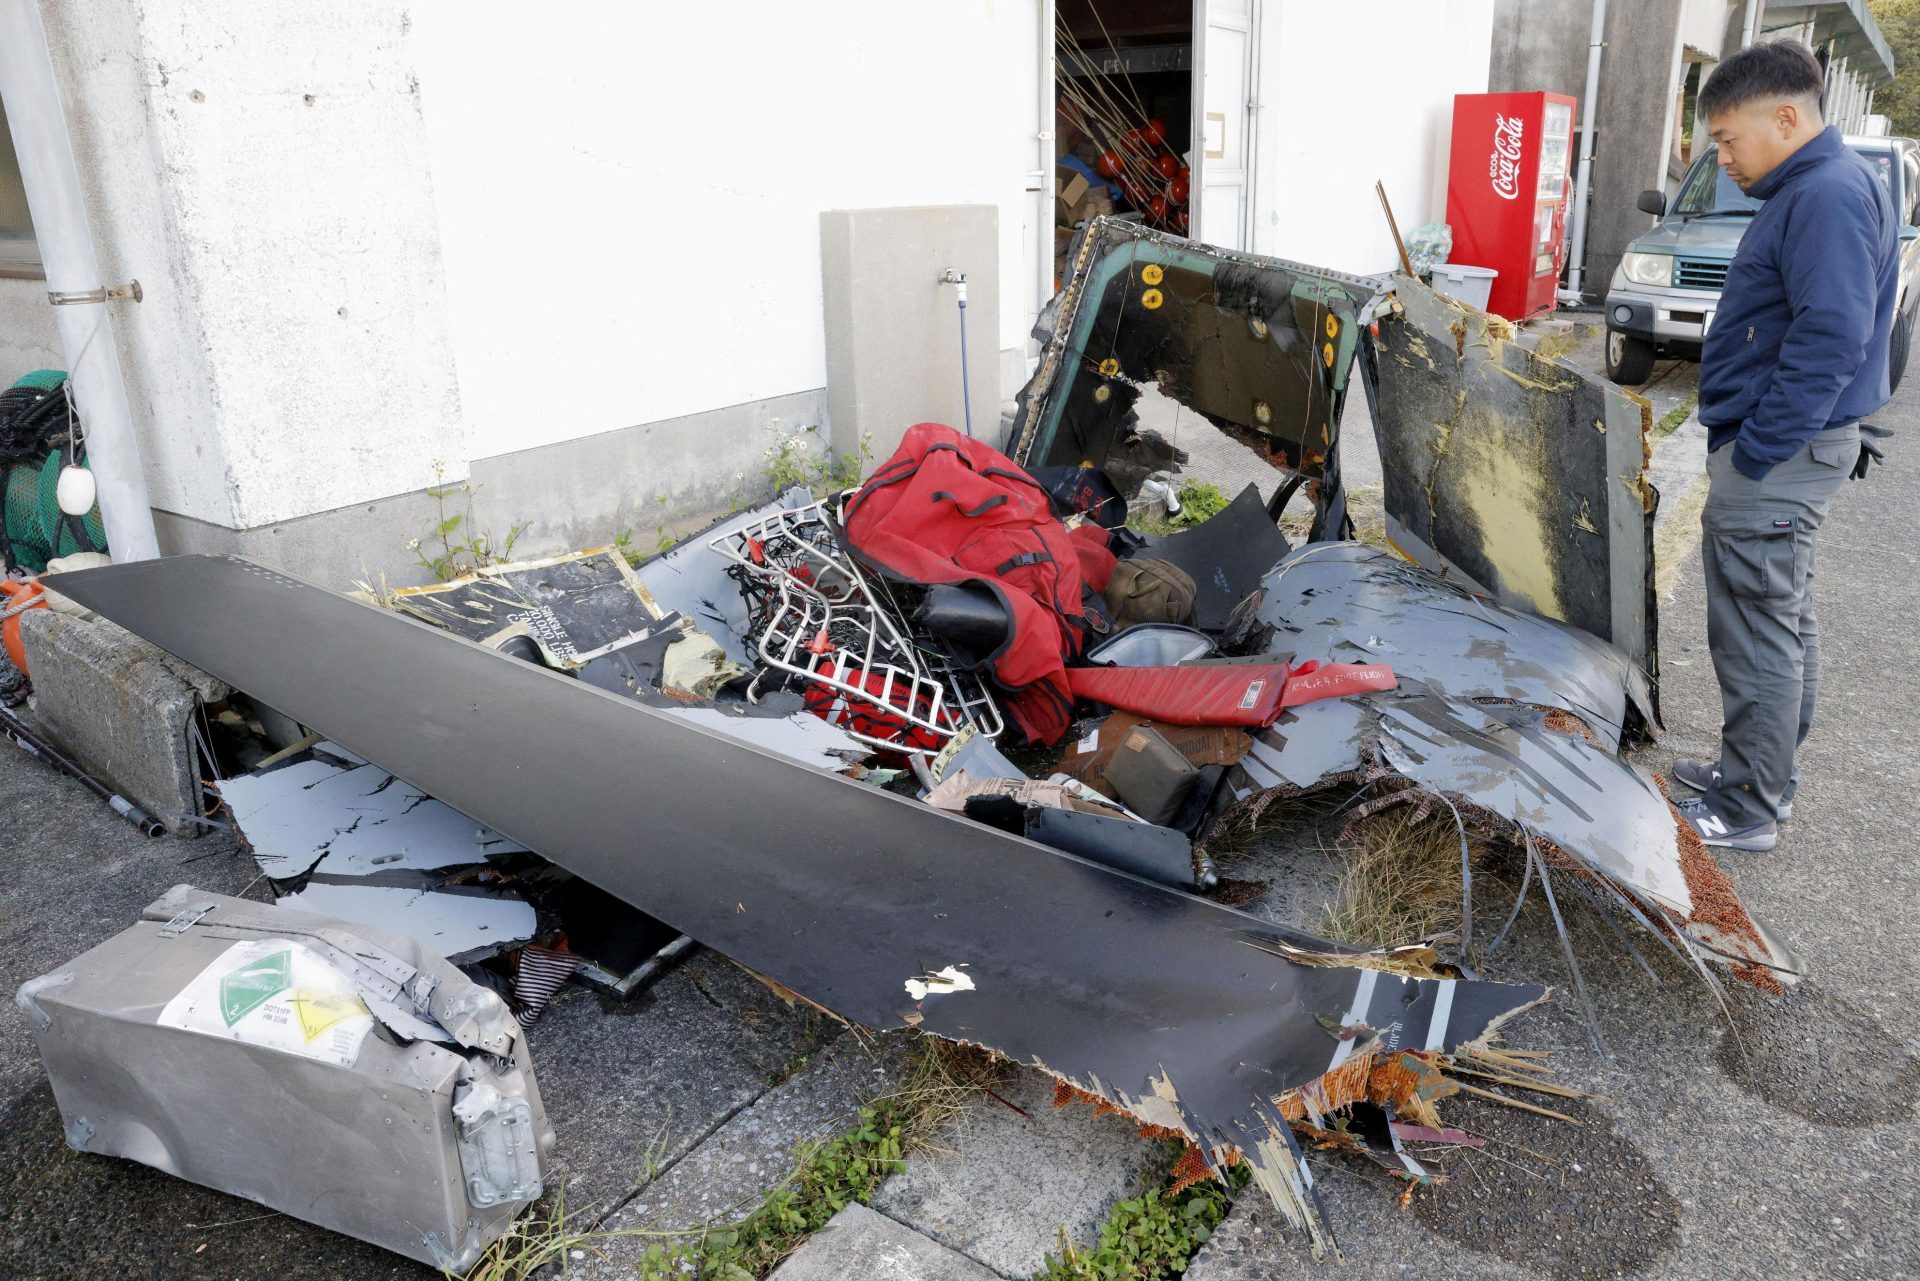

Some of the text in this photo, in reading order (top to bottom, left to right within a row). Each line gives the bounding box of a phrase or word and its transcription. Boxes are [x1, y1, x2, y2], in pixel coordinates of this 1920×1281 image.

[1492, 112, 1523, 200] Coca-Cola
[540, 605, 568, 639] SINGLE
[1695, 815, 1728, 836] N
[229, 1004, 240, 1016] 2
